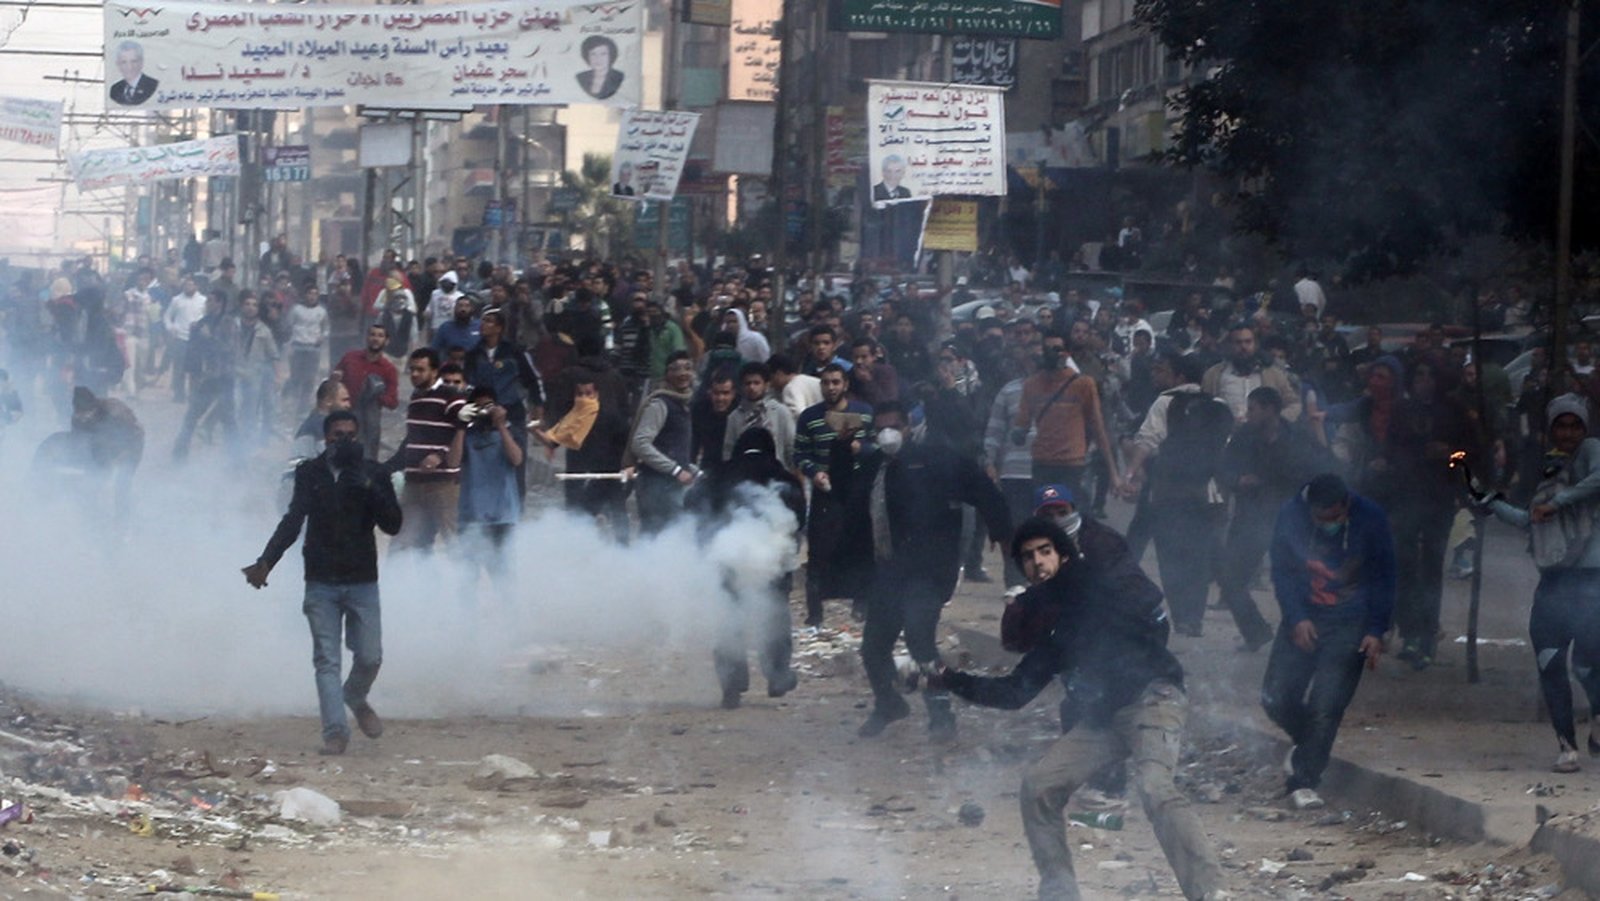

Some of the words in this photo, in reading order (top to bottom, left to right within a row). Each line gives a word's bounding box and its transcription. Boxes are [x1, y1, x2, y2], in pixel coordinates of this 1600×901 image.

[472, 8, 513, 30] حزب
[240, 41, 293, 62] المجيد
[297, 40, 347, 61] الميلاد
[350, 41, 389, 60] وعيد
[391, 36, 437, 55] السنة
[438, 36, 471, 59] رأس
[474, 40, 509, 59] بعيد
[181, 63, 224, 81] ندا
[227, 65, 286, 84] سعيد
[452, 60, 495, 82] عثمان
[498, 66, 527, 82] سحر
[450, 84, 470, 97] نصر
[471, 83, 498, 96] مدينة
[516, 83, 551, 96] سكرتير
[878, 89, 919, 104] للدستور
[923, 90, 939, 102] نعم
[942, 91, 963, 105] قول
[966, 90, 989, 105] انزل
[906, 106, 950, 119] نعم
[953, 106, 989, 121] قول
[982, 122, 992, 132] لا
[907, 153, 928, 167] ندا
[931, 157, 964, 169] سعيد
[970, 157, 993, 168] دكتور
